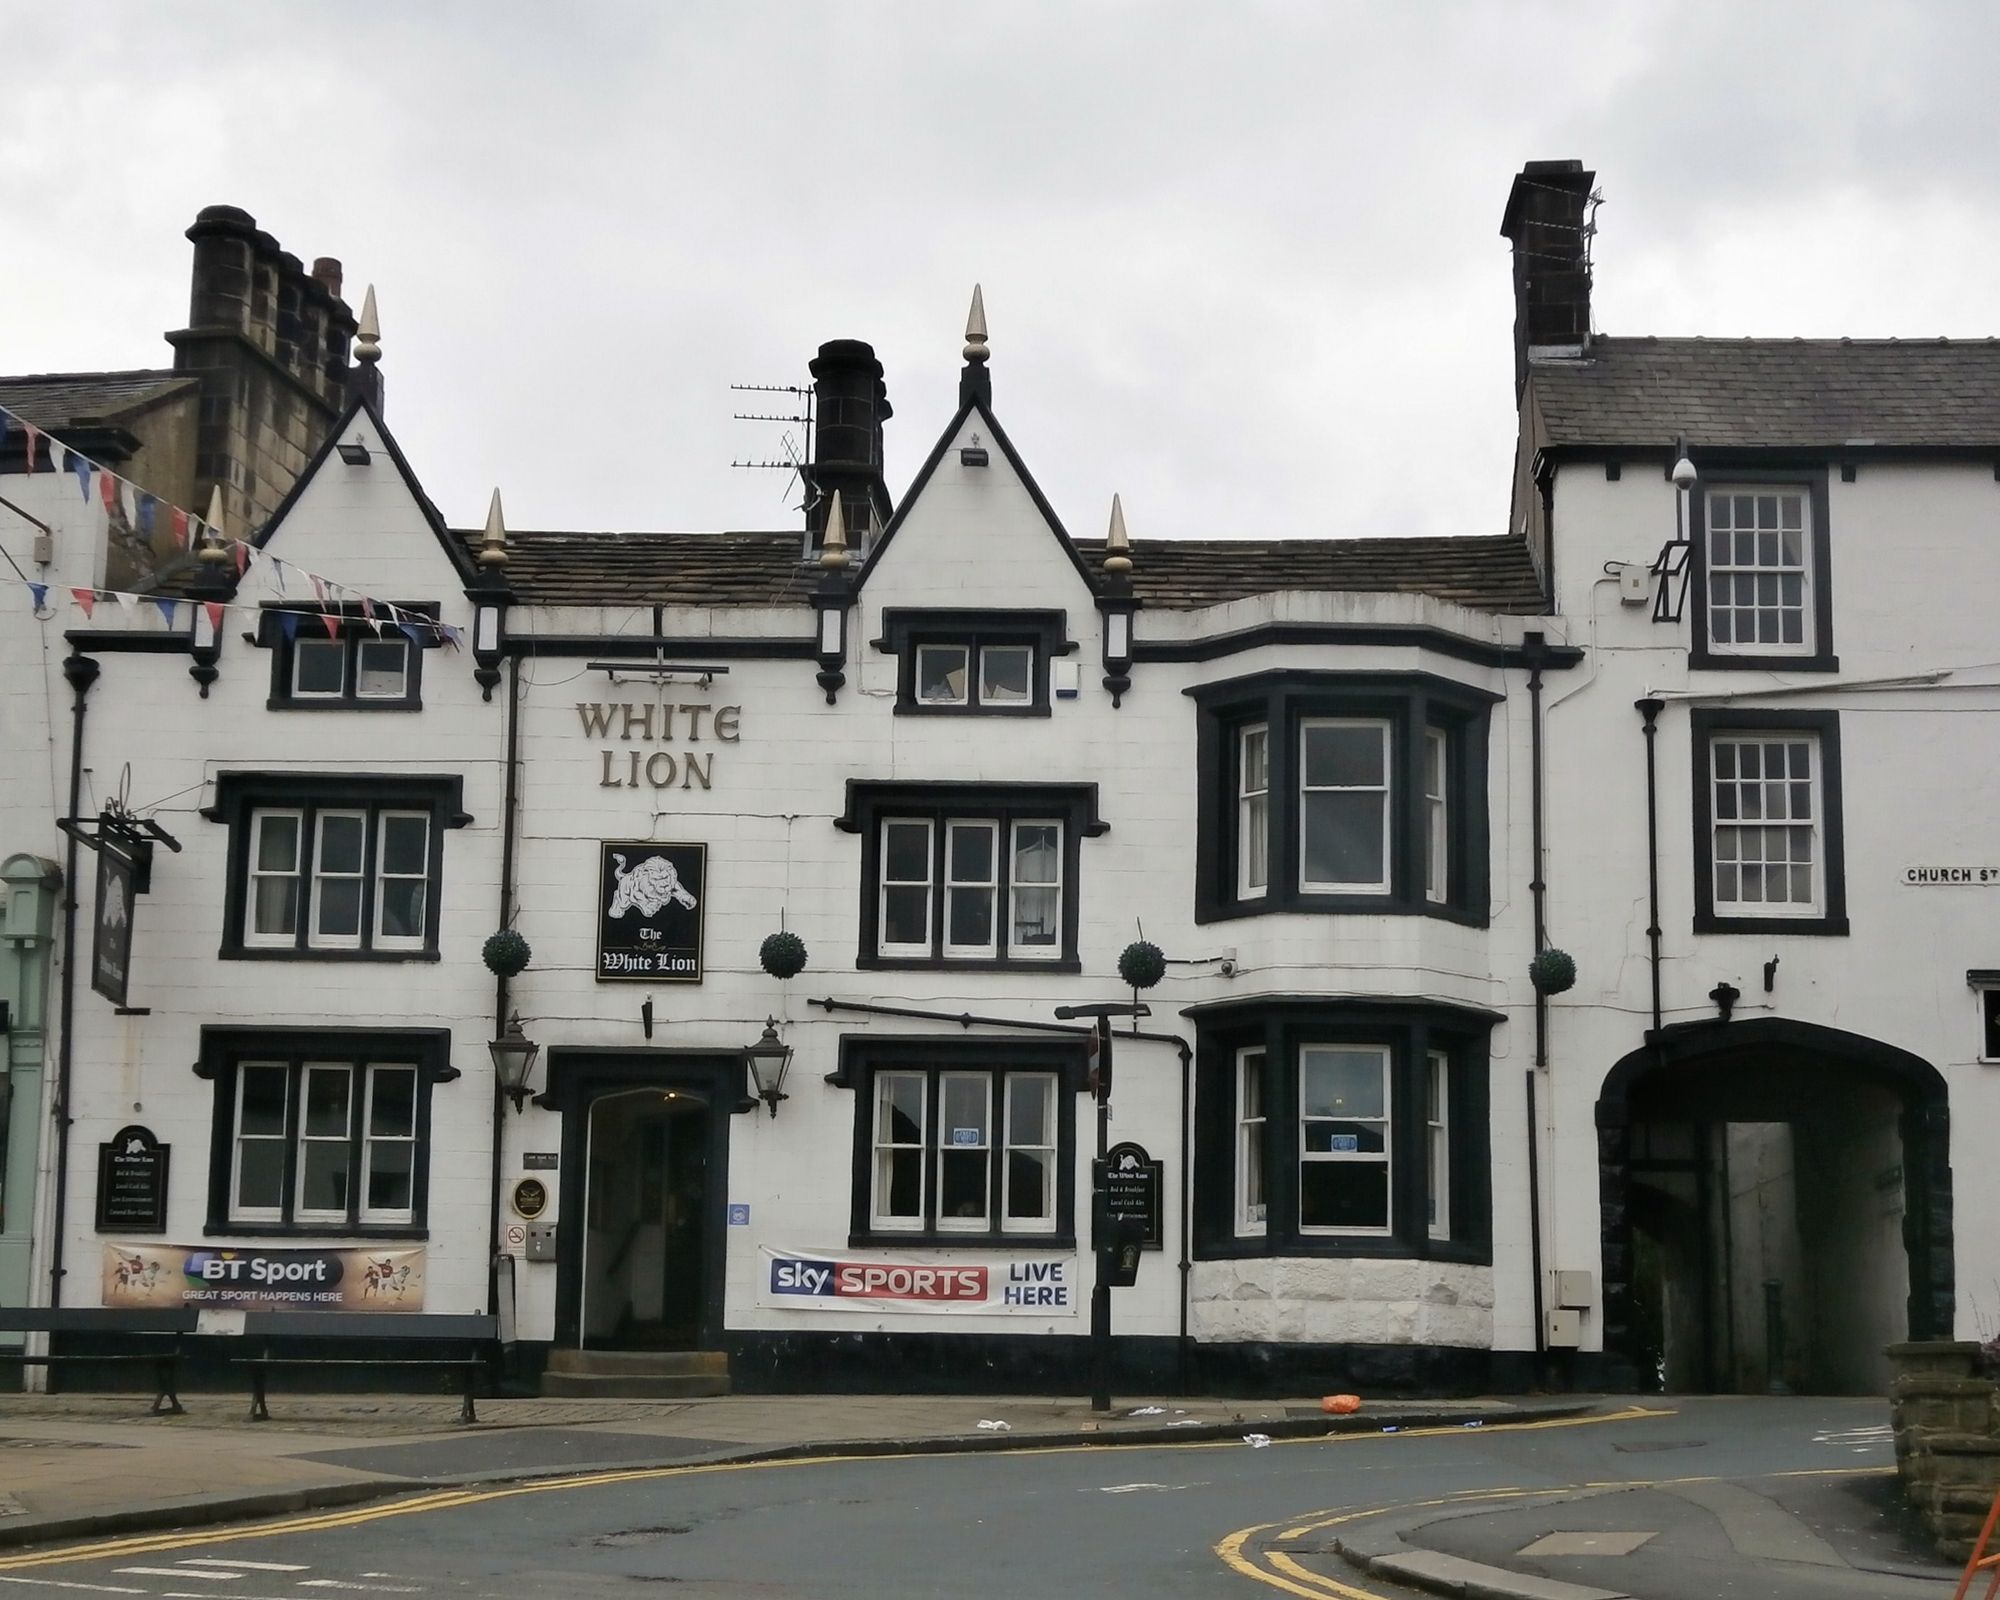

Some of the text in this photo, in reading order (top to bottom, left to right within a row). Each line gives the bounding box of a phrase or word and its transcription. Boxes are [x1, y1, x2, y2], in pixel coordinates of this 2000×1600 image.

[576, 703, 741, 742] WHITE
[600, 750, 714, 789] LION
[1907, 869, 1971, 881] CHURCH
[639, 928, 662, 940] The
[602, 953, 696, 973] White Lion
[203, 1257, 326, 1284] BT Sport
[777, 1262, 981, 1296] sky SPORTS
[1010, 1263, 1064, 1282] LIVE
[182, 1290, 343, 1302] GREAT SPORT HAPPENS HERE
[1004, 1286, 1068, 1306] HERE
